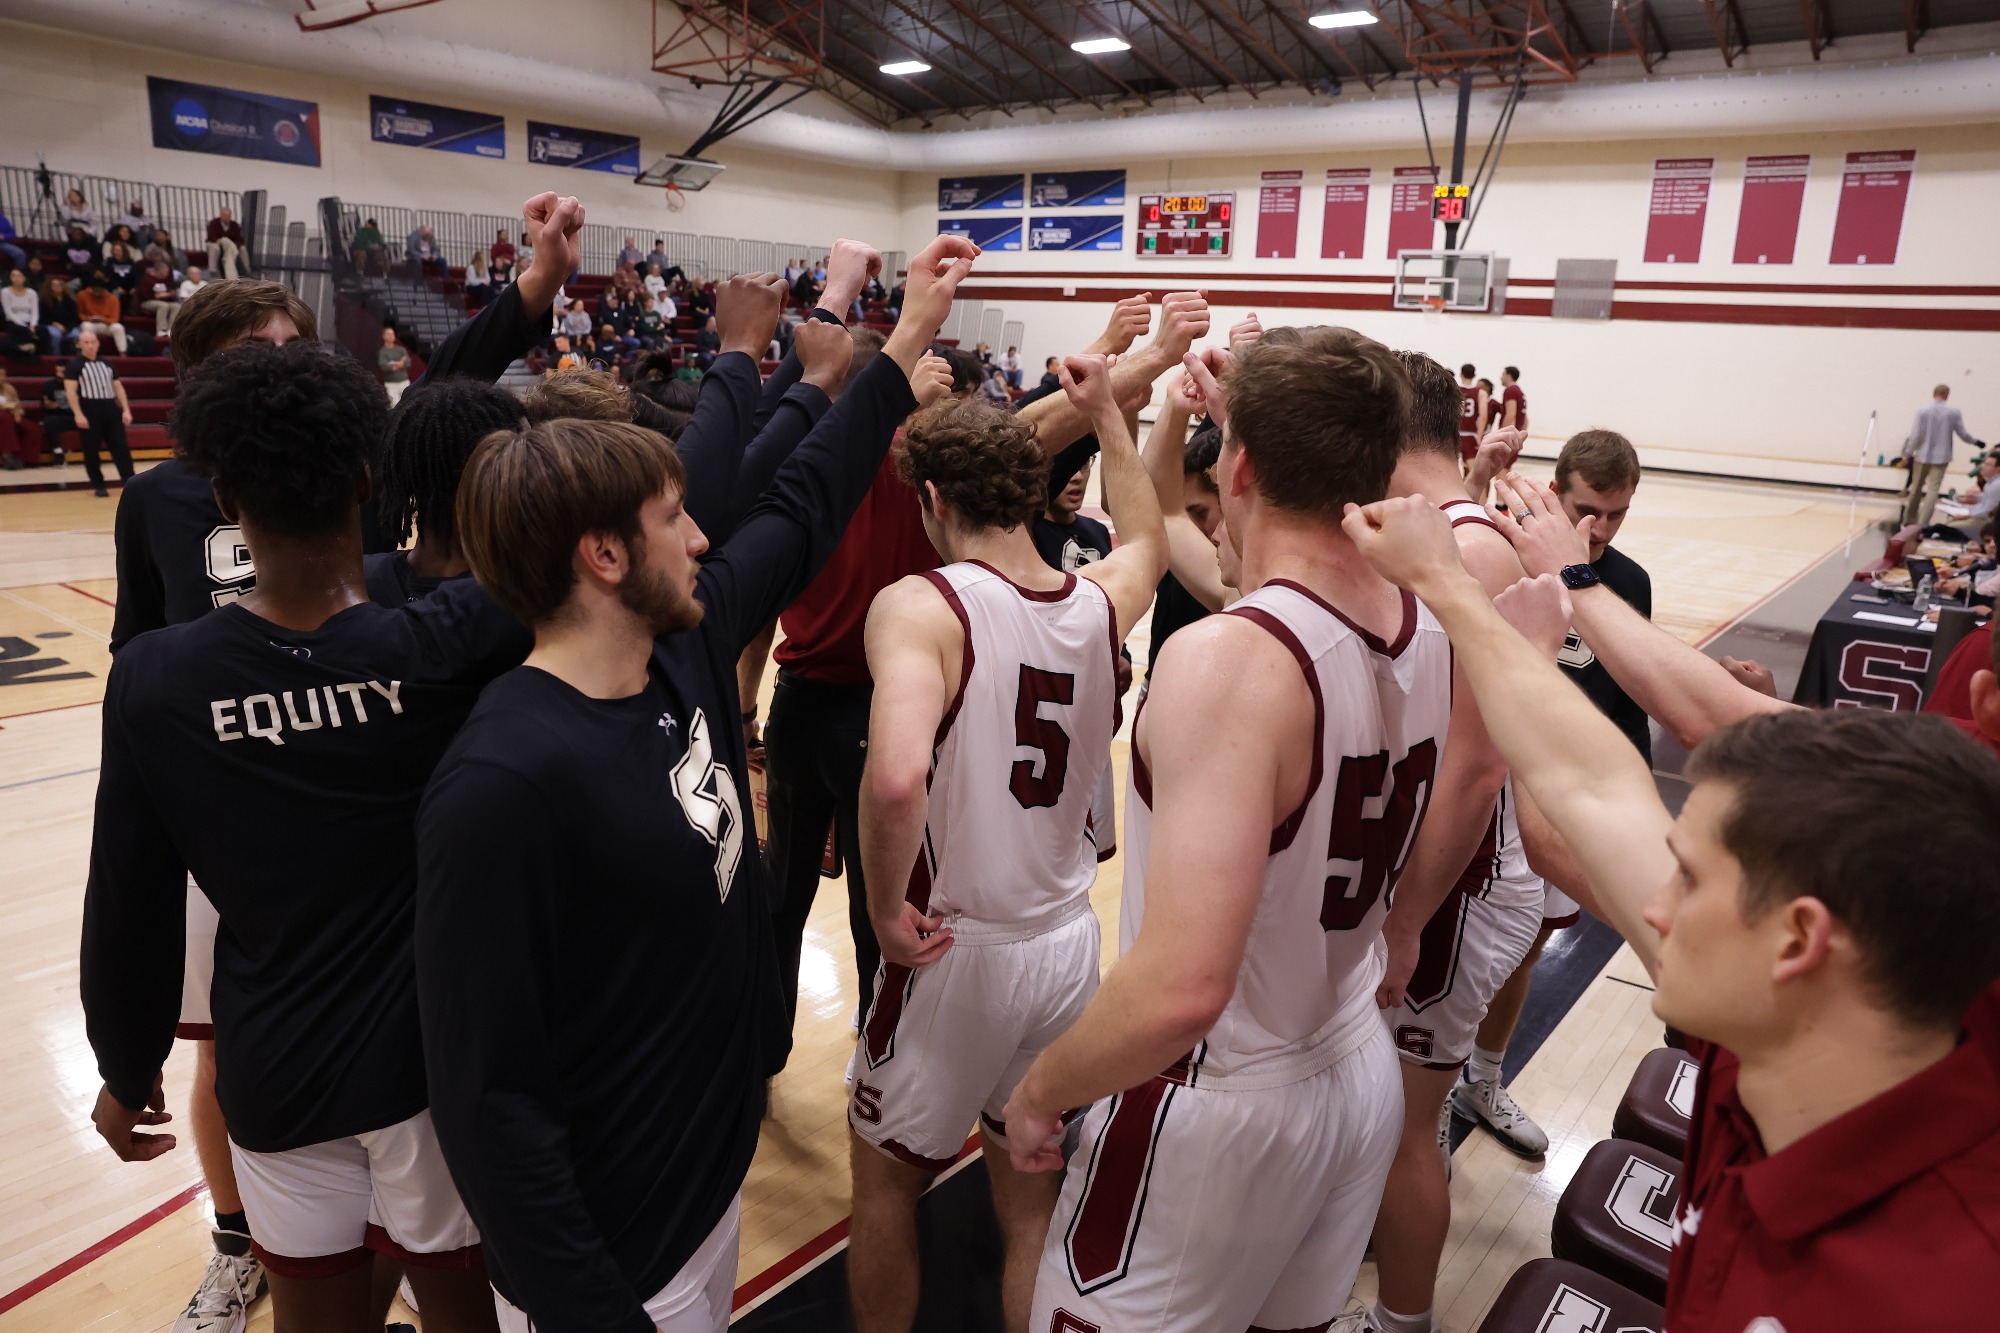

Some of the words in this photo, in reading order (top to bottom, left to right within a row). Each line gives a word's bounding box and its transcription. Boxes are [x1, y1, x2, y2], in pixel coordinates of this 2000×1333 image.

[175, 114, 208, 129] NCAA
[1150, 205, 1159, 221] 0
[1164, 196, 1205, 212] 20:00
[1220, 204, 1230, 220] 0
[1438, 198, 1463, 219] 30
[1834, 639, 1932, 714] S
[211, 680, 403, 746] EQUITY
[1009, 663, 1074, 809] 5
[1319, 736, 1437, 933] 50
[854, 1079, 883, 1126] S
